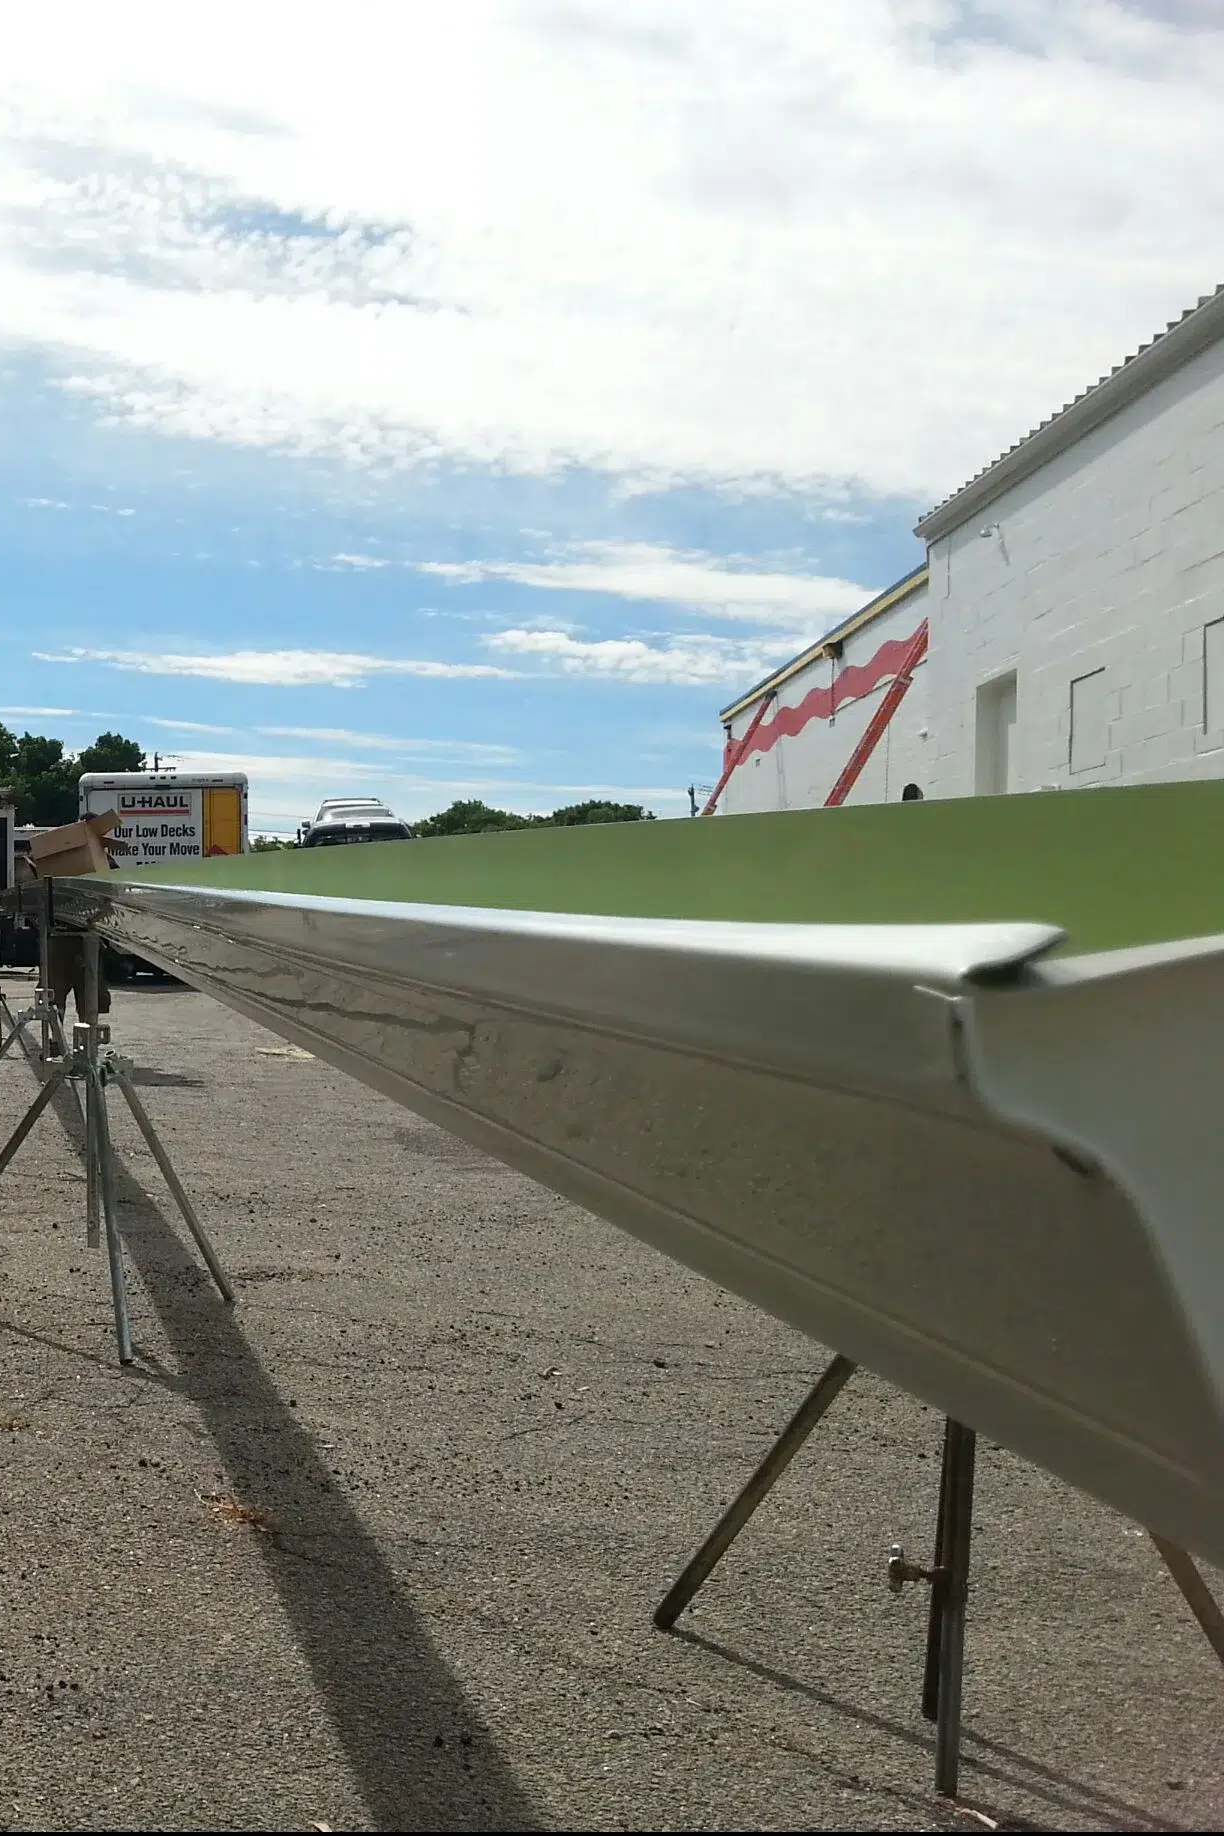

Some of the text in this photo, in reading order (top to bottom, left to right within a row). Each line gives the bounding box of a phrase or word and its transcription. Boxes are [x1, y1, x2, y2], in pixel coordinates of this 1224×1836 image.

[121, 795, 189, 808] U-HAUL
[114, 823, 196, 838] Our Low Decks
[142, 842, 166, 856] Your
[169, 842, 200, 856] Move
